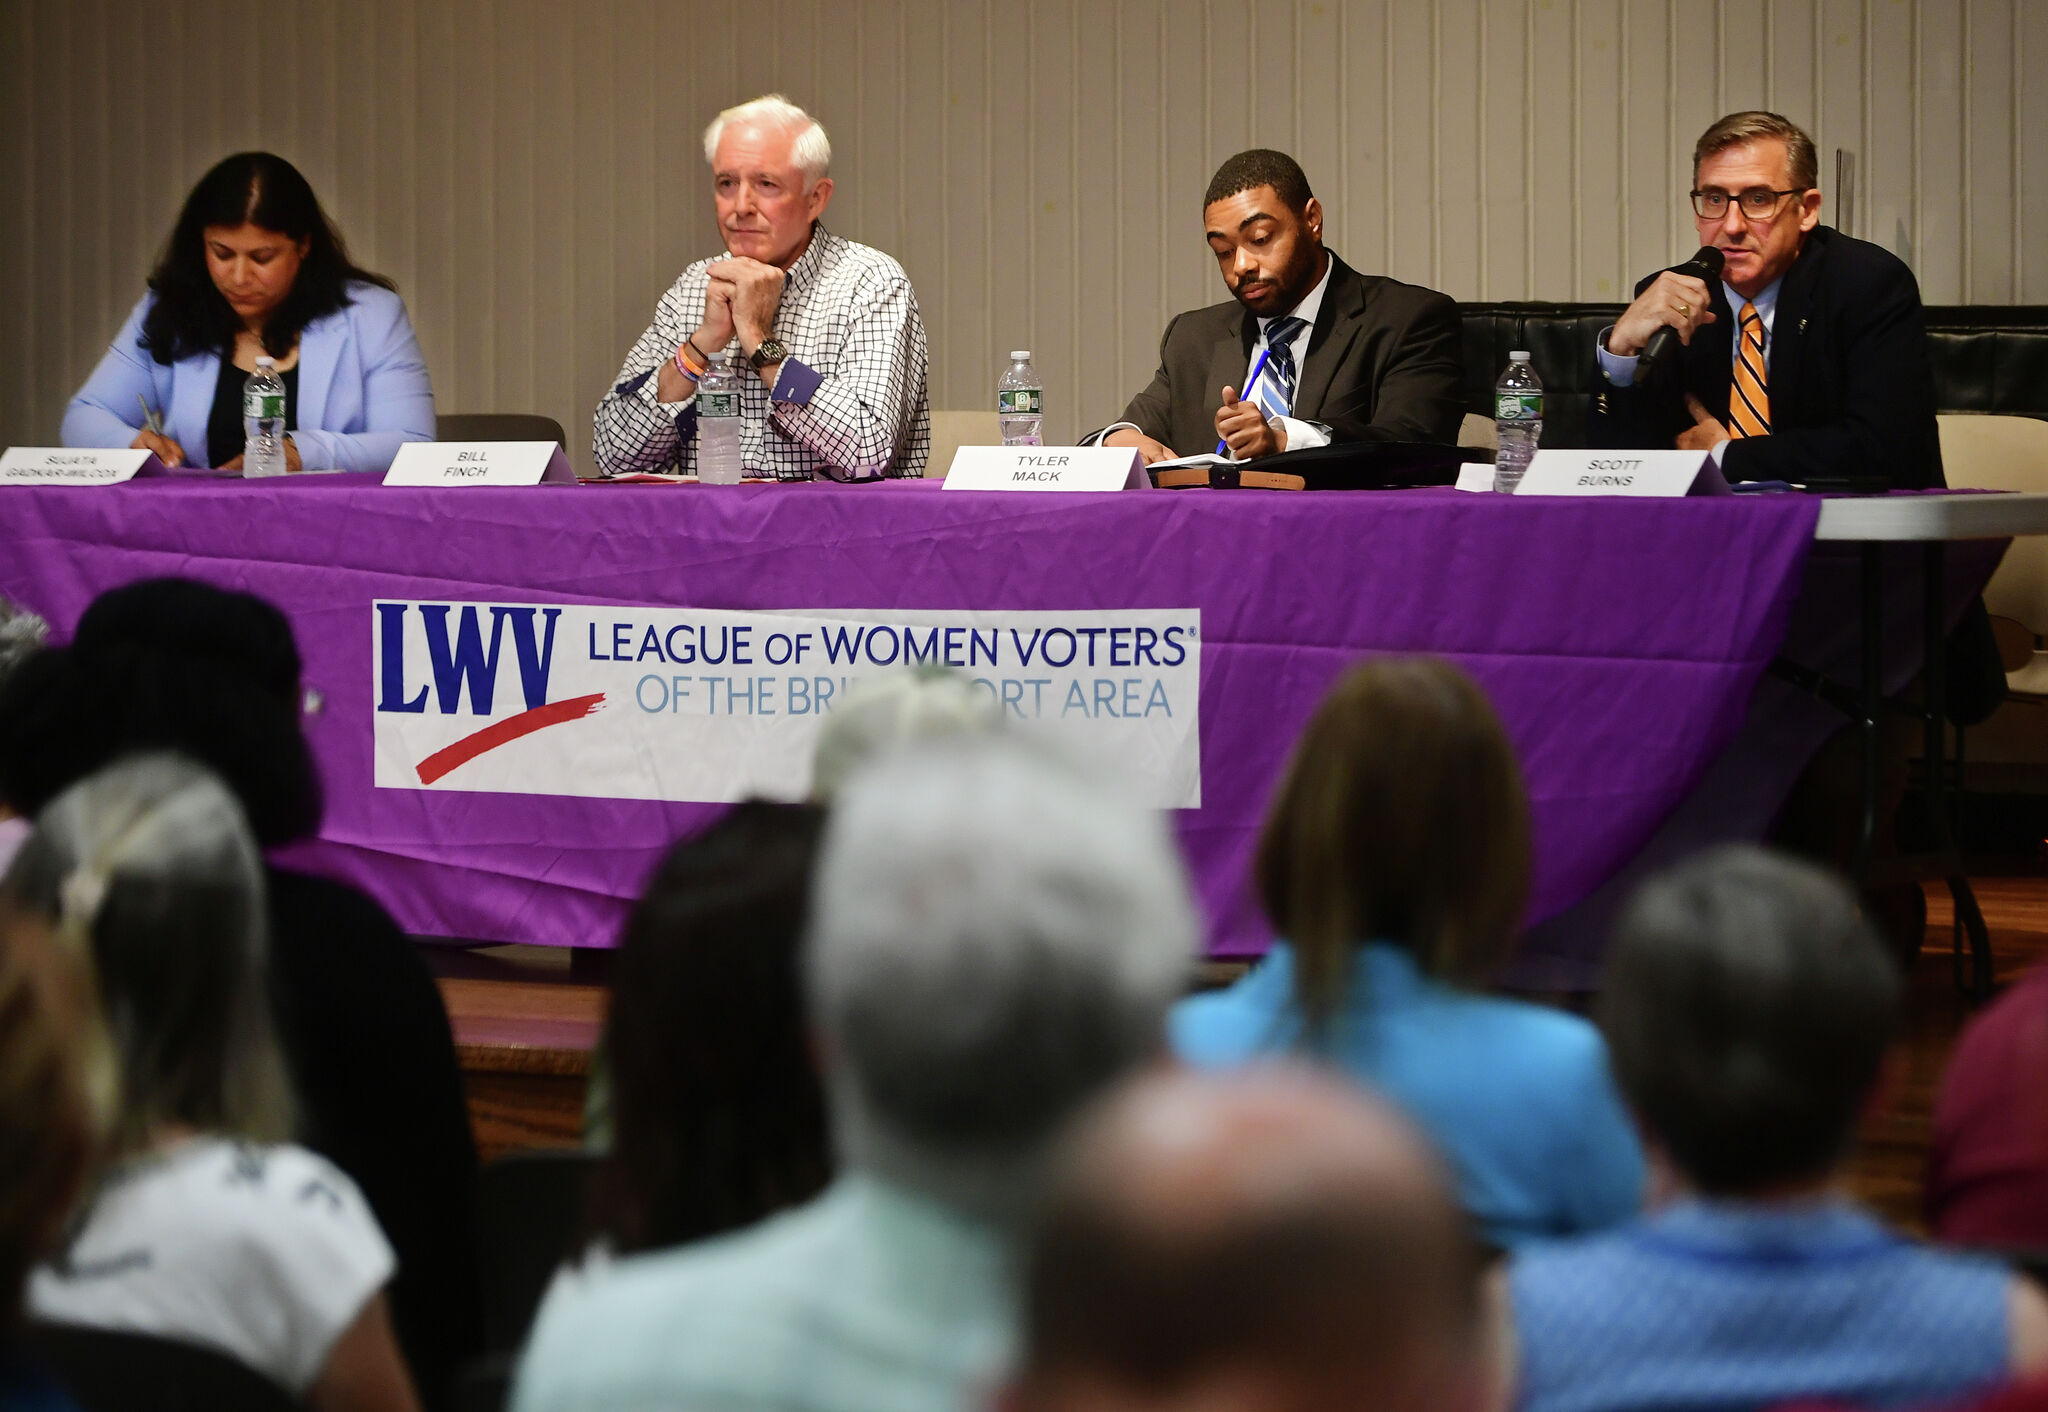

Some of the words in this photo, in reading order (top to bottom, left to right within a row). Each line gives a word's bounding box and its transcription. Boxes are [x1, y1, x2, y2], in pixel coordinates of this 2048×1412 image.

[457, 452, 487, 462] BILL
[1017, 455, 1070, 467] TYLER
[1587, 459, 1643, 471] SCOTT
[443, 466, 489, 477] FINCH
[1011, 471, 1063, 482] MACK
[1576, 475, 1635, 487] BURNS
[589, 622, 753, 665] LEAGUE
[765, 633, 812, 665] OF
[821, 625, 998, 667] WOMEN
[377, 603, 561, 715] LWV
[636, 674, 692, 714] OF
[700, 677, 776, 715] THE
[1061, 679, 1173, 718] AREA
